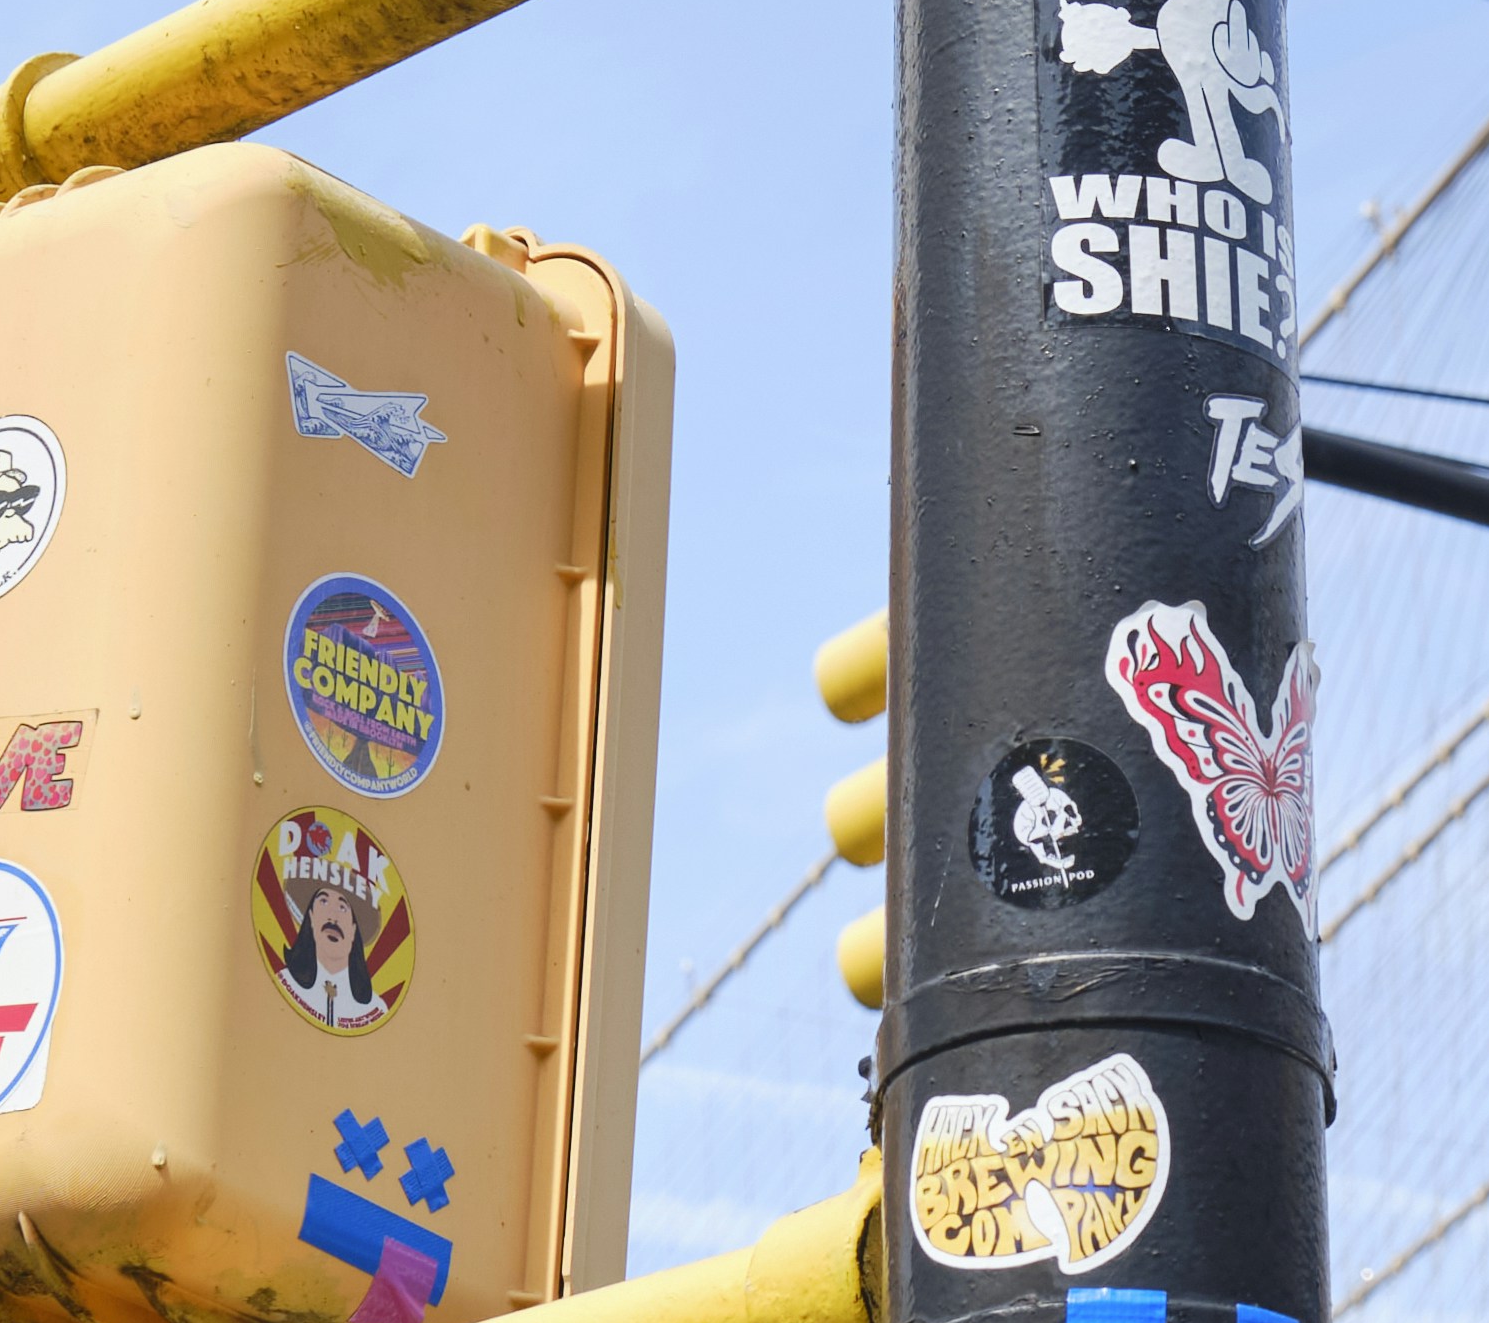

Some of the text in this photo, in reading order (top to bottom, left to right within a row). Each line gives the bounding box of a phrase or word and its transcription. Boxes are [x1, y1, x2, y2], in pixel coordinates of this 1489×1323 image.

[1049, 173, 1296, 279] WHO IS
[1050, 221, 1297, 361] SHIE?
[293, 656, 435, 741] COMPANY
[303, 627, 428, 707] FRIENDLY
[283, 855, 382, 910] HENSLEY
[1011, 869, 1095, 894] PASSION POD
[918, 1104, 999, 1178] HACK
[1047, 1062, 1157, 1142] SACK
[916, 1130, 1159, 1231] BREWING
